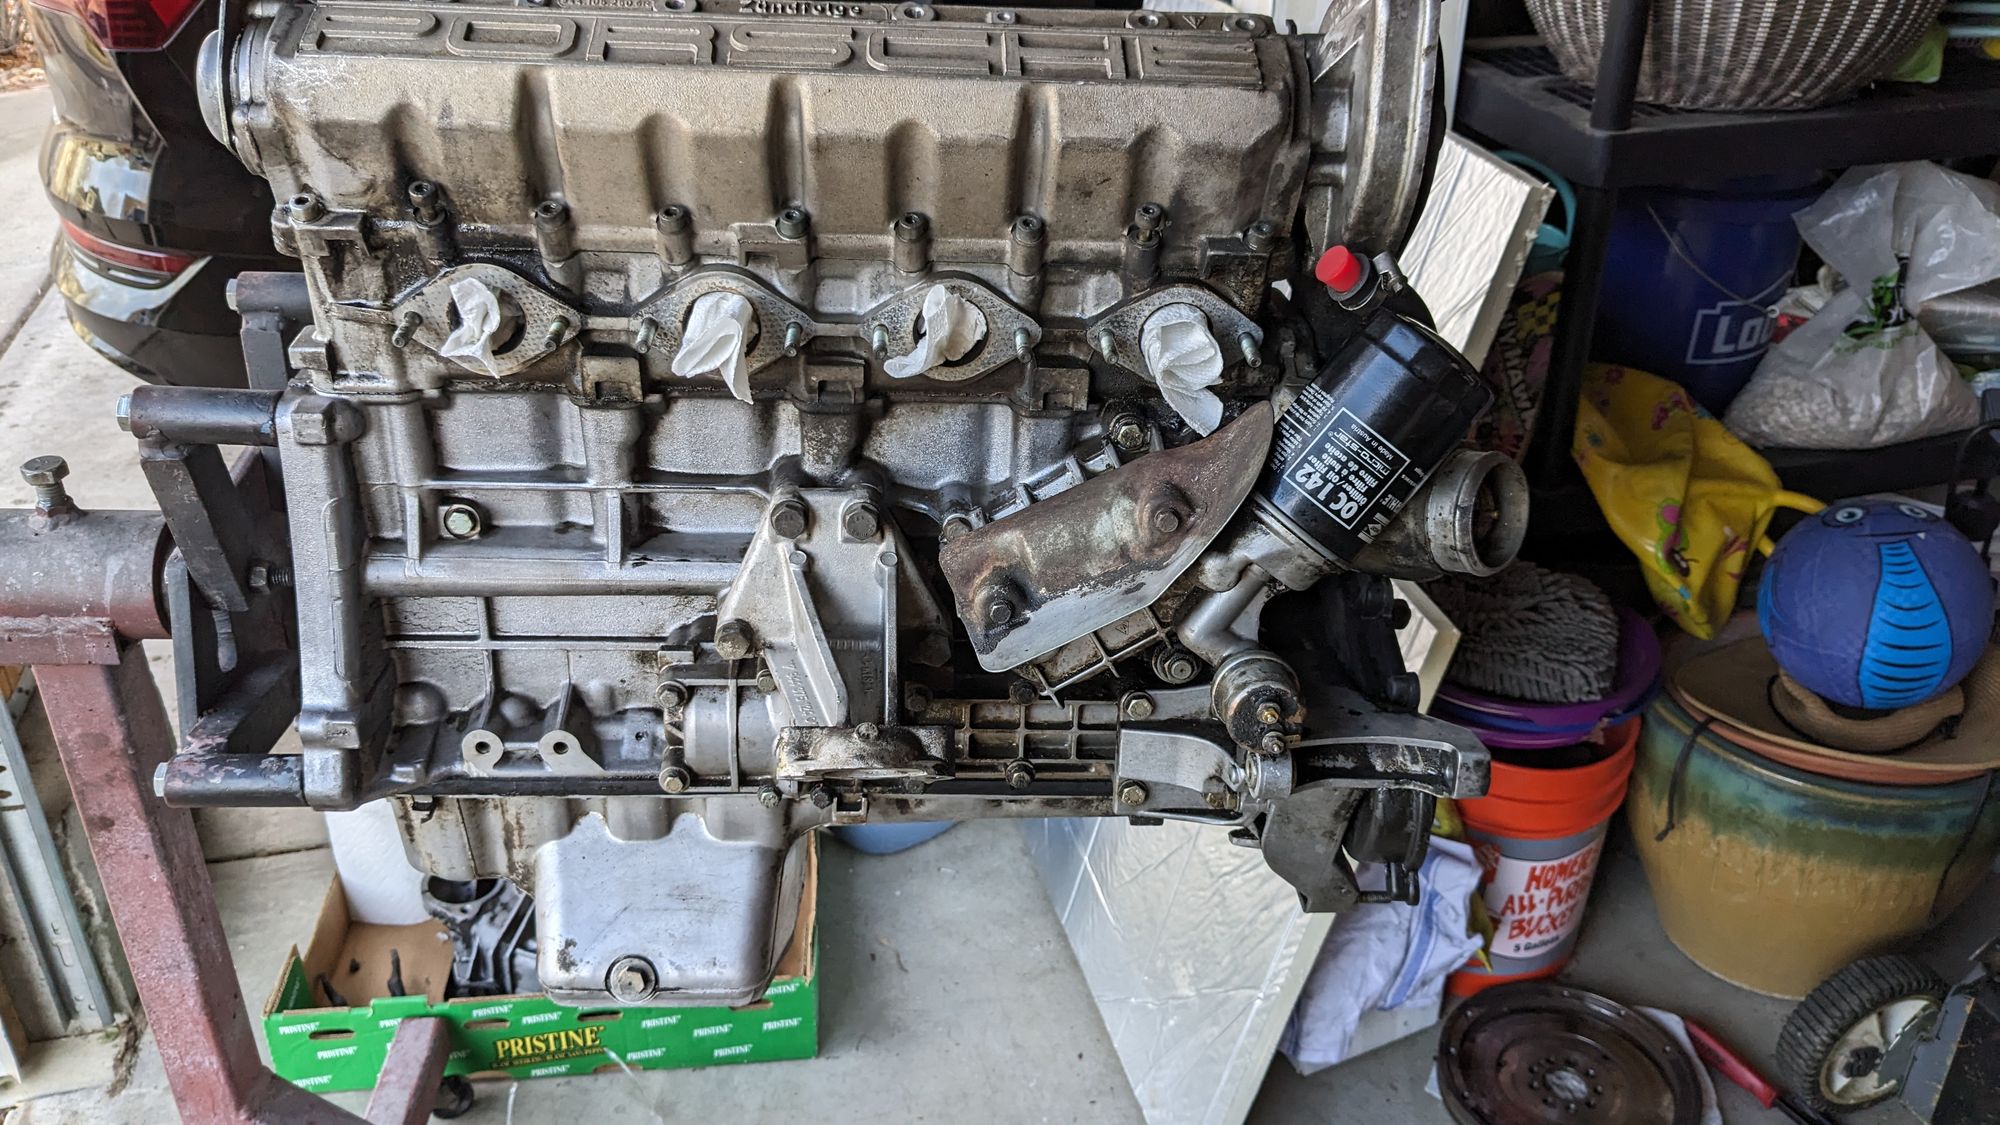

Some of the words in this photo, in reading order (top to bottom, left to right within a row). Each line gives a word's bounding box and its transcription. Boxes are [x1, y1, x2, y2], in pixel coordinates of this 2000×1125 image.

[299, 8, 1261, 84] PORSCHE
[1350, 423, 1372, 442] Austria
[1324, 442, 1348, 462] aceite
[1370, 440, 1379, 449] in
[1377, 445, 1394, 461] Made
[1307, 454, 1329, 474] Filter
[1321, 452, 1342, 473] huile
[1347, 460, 1359, 472] de
[1294, 462, 1335, 501] 142
[1340, 468, 1349, 478] à
[1358, 469, 1379, 488] Filtro
[1348, 474, 1369, 493] Filtre
[1328, 491, 1362, 520] OC
[1513, 944, 1521, 953] 5
[496, 1026, 601, 1059] PRISTINE
